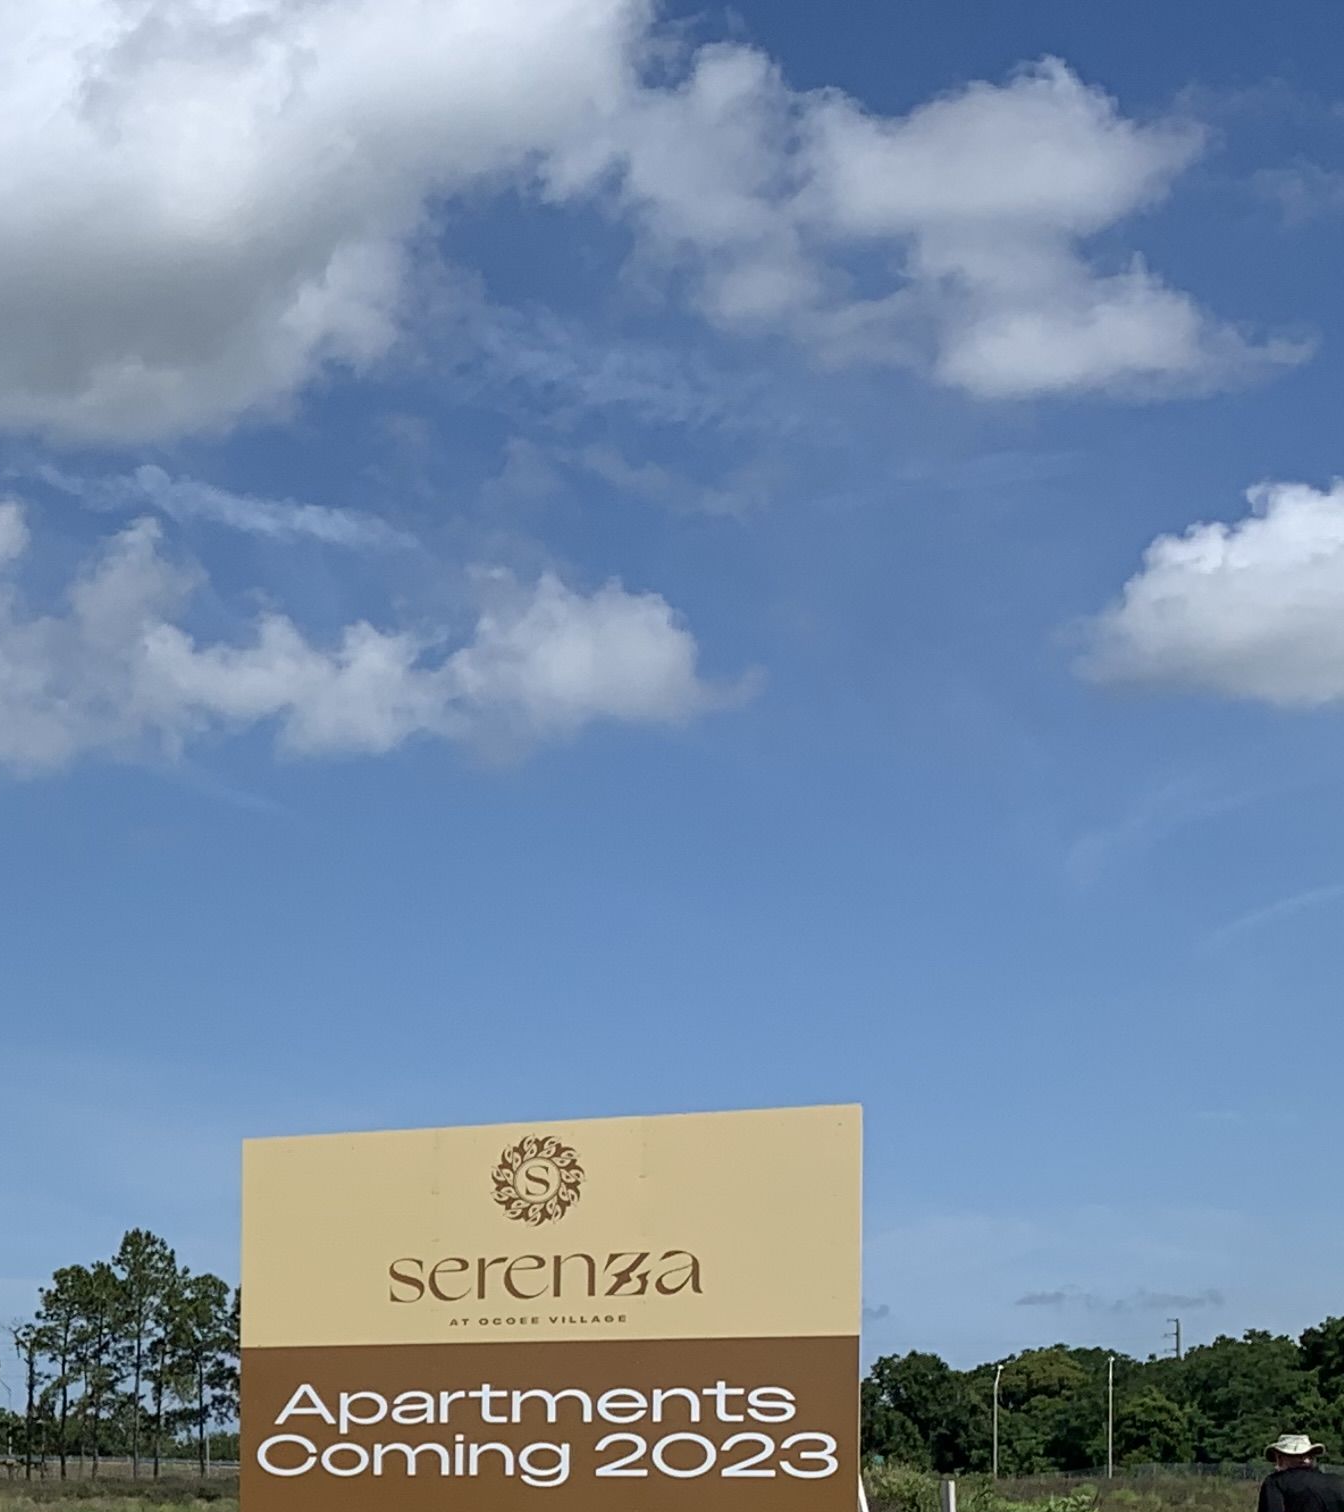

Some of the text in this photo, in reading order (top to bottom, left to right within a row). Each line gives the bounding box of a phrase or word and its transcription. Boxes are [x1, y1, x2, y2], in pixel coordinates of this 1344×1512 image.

[524, 1164, 550, 1197] S
[388, 1249, 704, 1304] serenza
[448, 1314, 628, 1327] AT OCOEE VILLAGE
[273, 1380, 797, 1434] Apartments
[256, 1431, 840, 1488] Coming 2023
